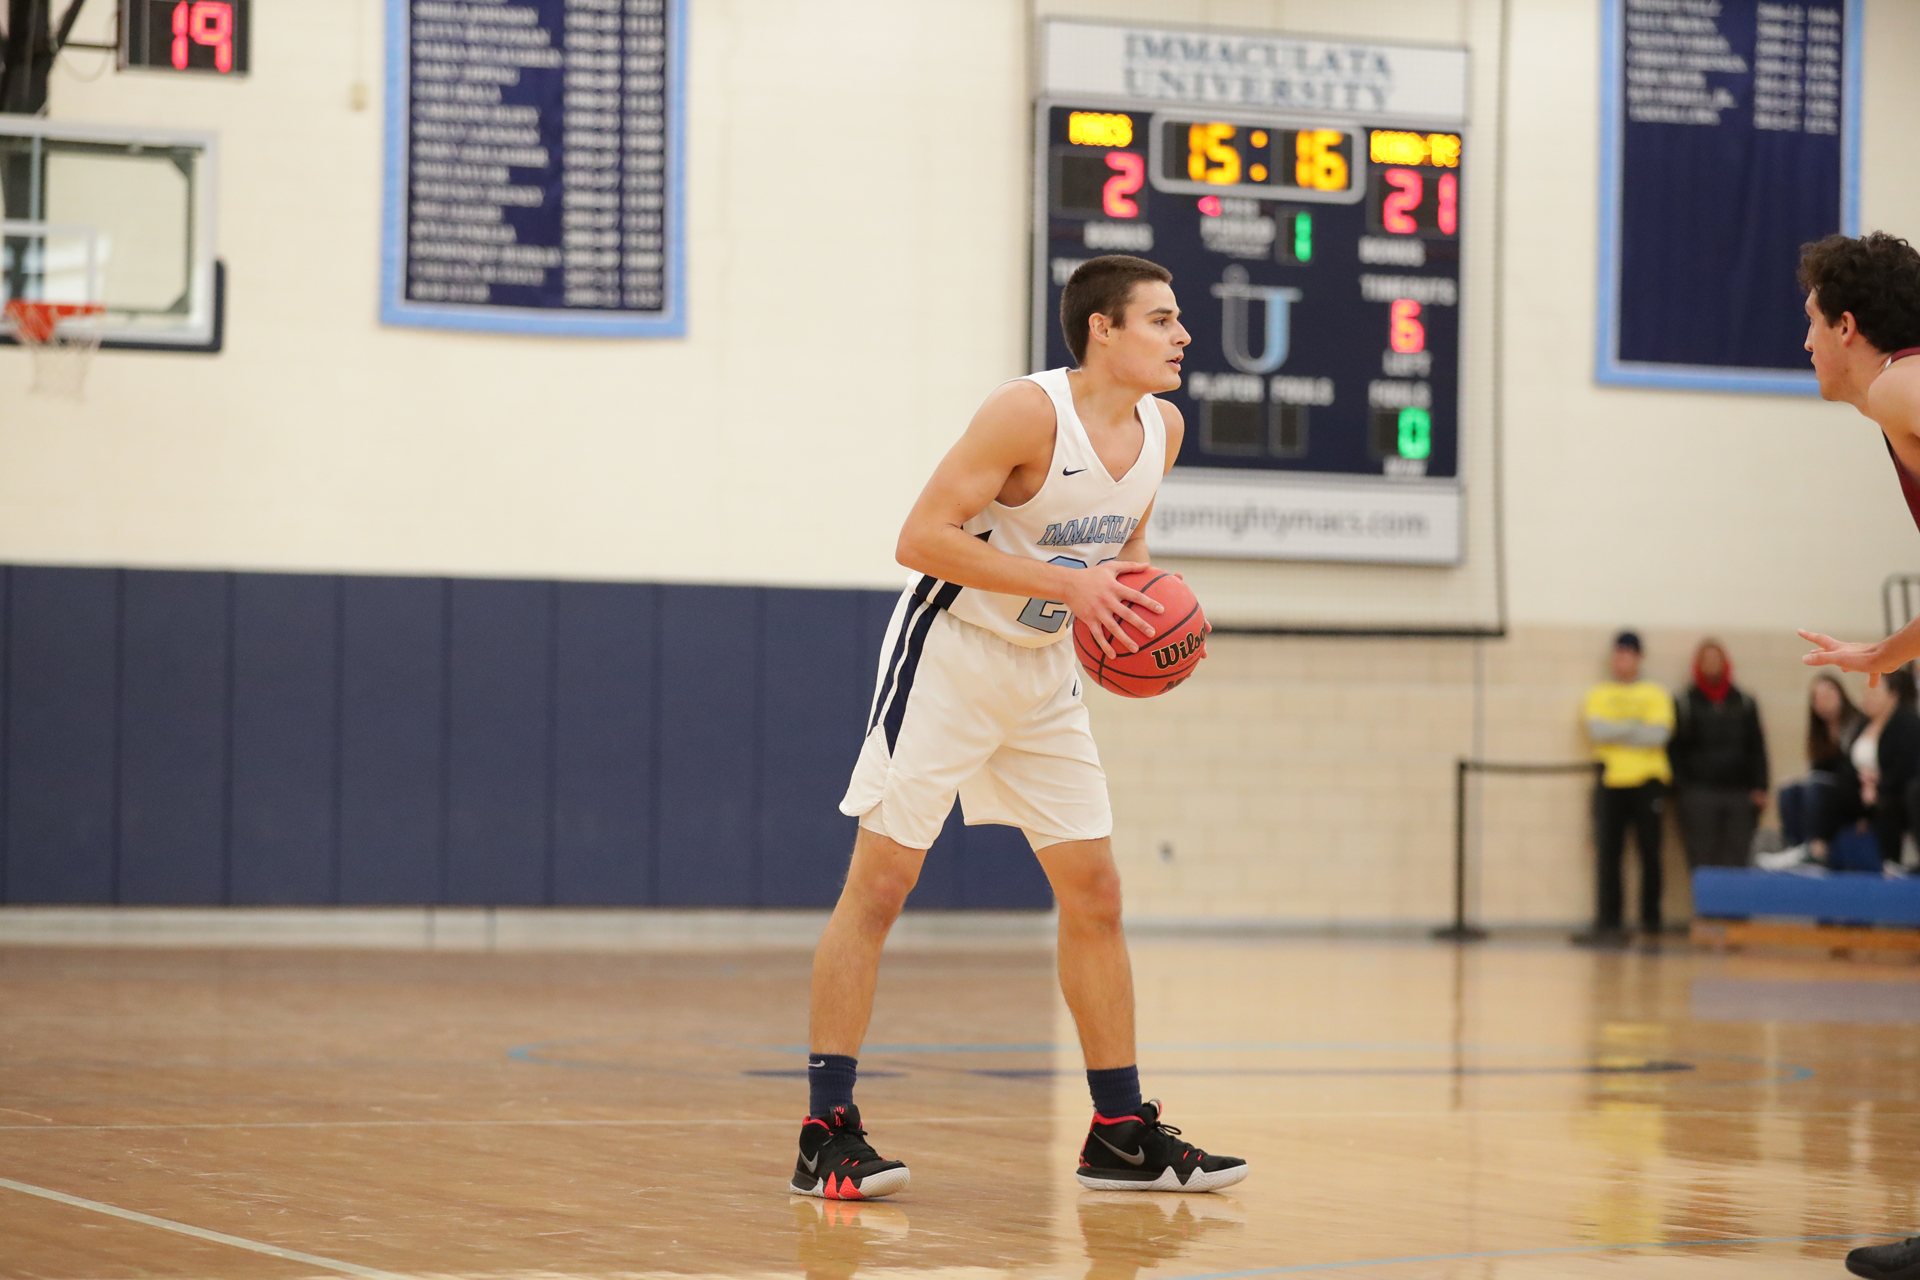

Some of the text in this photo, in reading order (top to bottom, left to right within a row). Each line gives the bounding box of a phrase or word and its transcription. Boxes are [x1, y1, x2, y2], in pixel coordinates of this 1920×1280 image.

[171, 0, 232, 73] 19
[1124, 33, 1393, 77] IMMACULATA
[1124, 67, 1390, 111] UNIVERSITY
[1188, 121, 1349, 192] 15:16
[1103, 151, 1145, 219] 2
[1383, 168, 1458, 235] 21
[1295, 211, 1312, 262] 1
[1391, 299, 1424, 354] 6
[1398, 407, 1431, 460] 0
[1037, 515, 1139, 547] IMMACULA
[1151, 622, 1206, 670] Wilso
